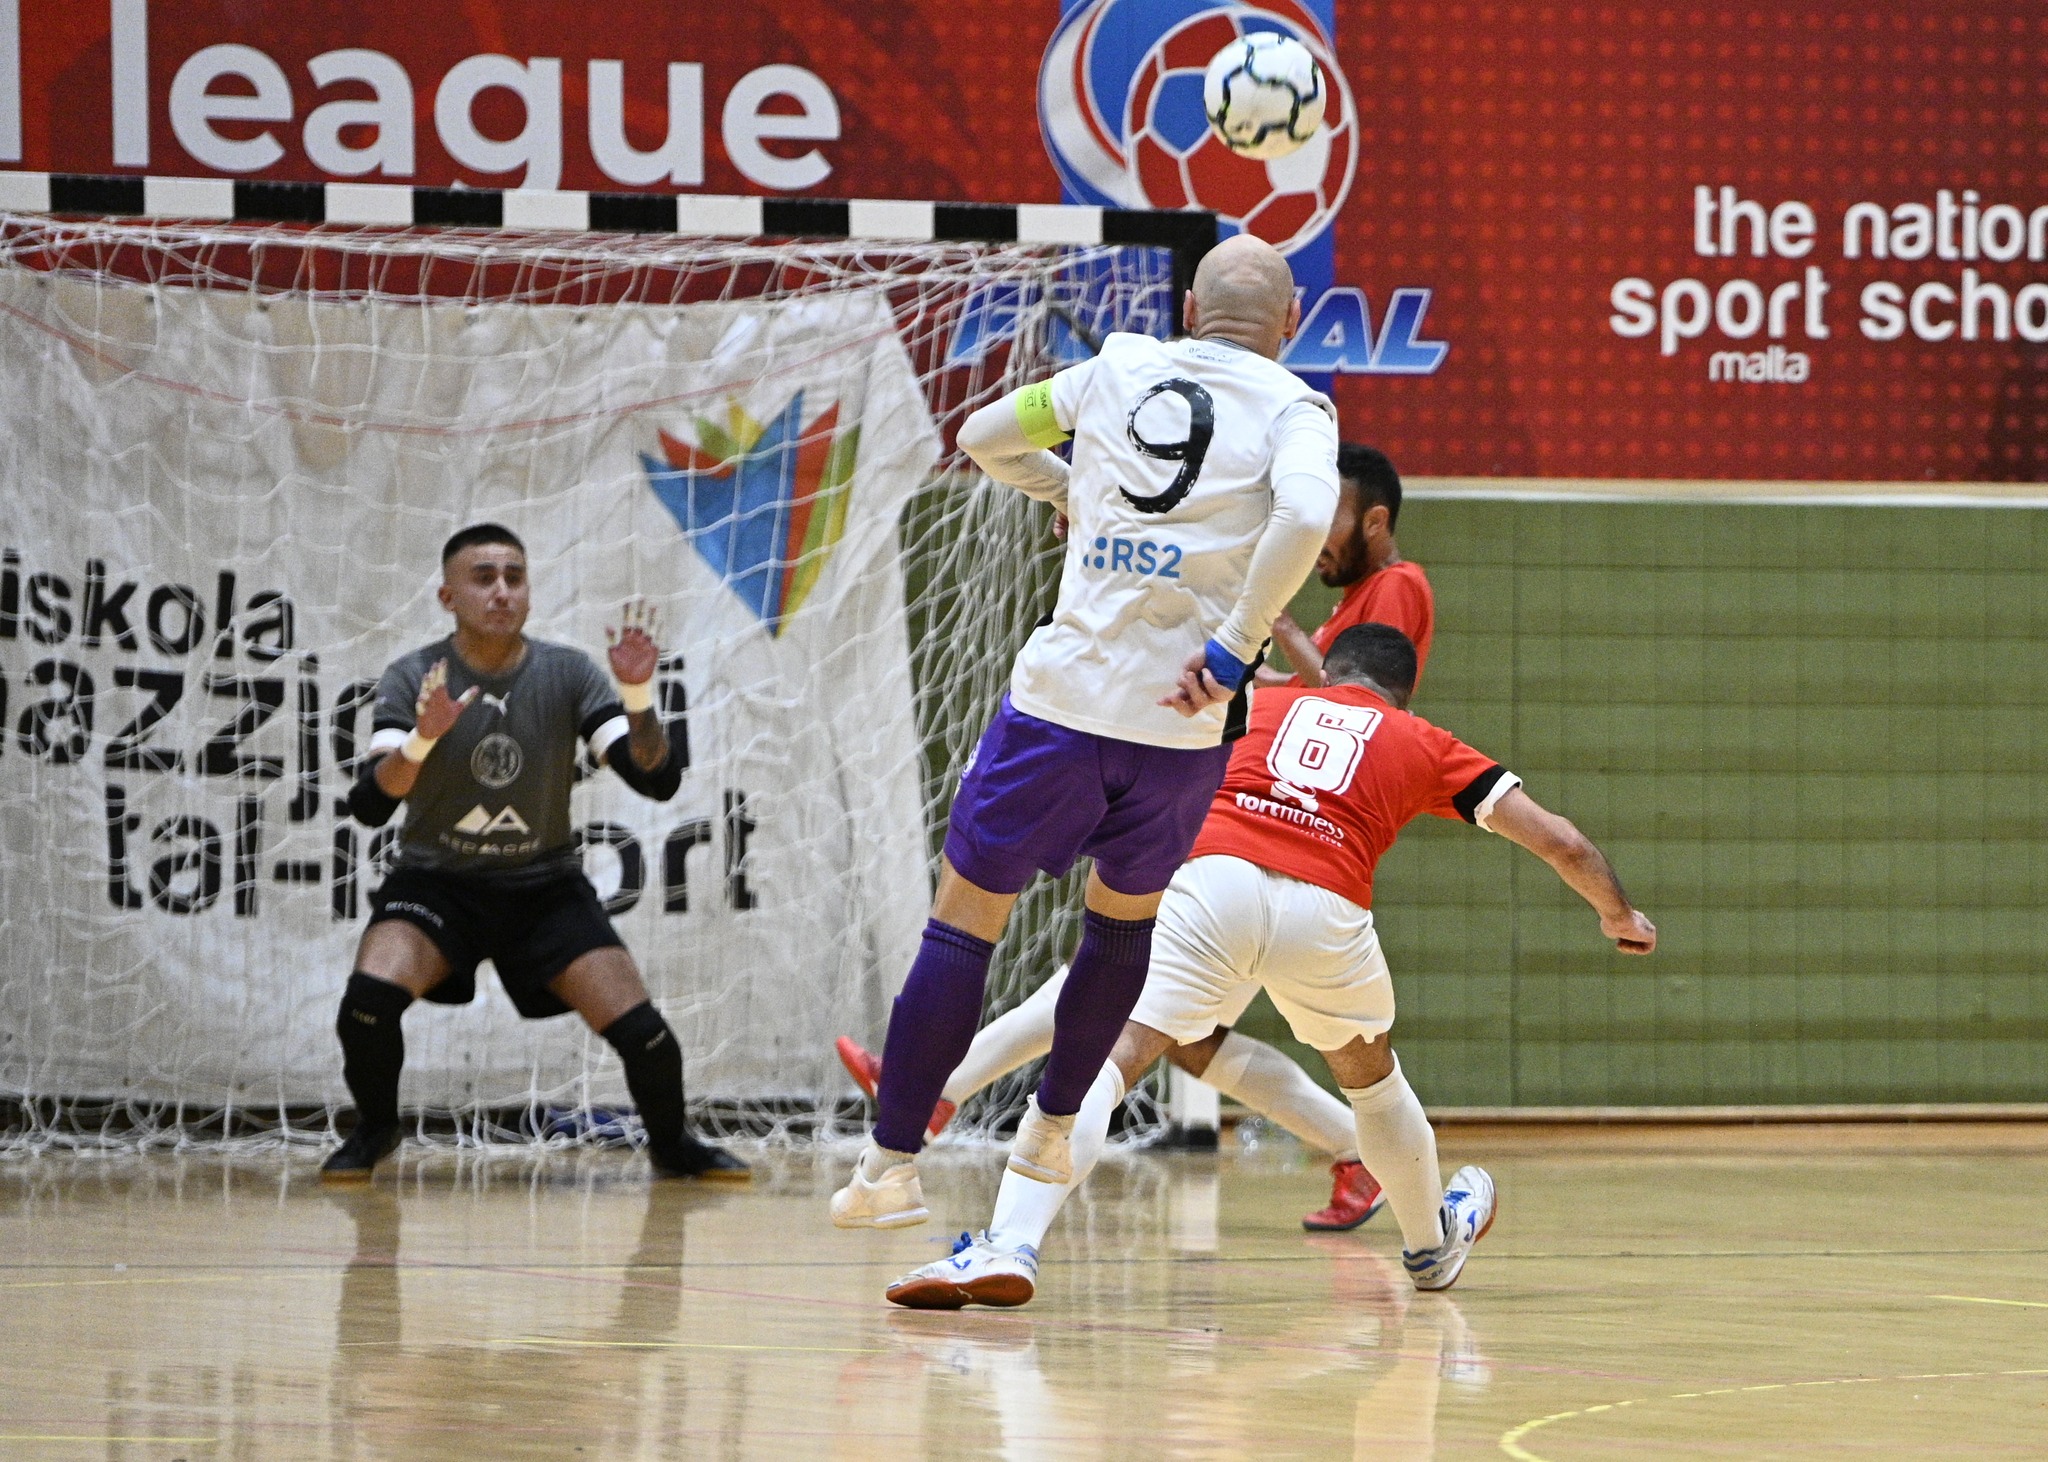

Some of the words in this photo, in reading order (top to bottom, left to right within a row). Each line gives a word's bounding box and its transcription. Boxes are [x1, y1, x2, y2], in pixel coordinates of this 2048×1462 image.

[111, 0, 841, 192] league
[1695, 185, 1817, 258] the
[1610, 266, 1831, 356] sport
[1708, 346, 1811, 383] malta
[1119, 377, 1214, 513] 9
[0, 547, 294, 661] iskola
[1111, 537, 1182, 579] RS2
[1266, 696, 1384, 796] 6
